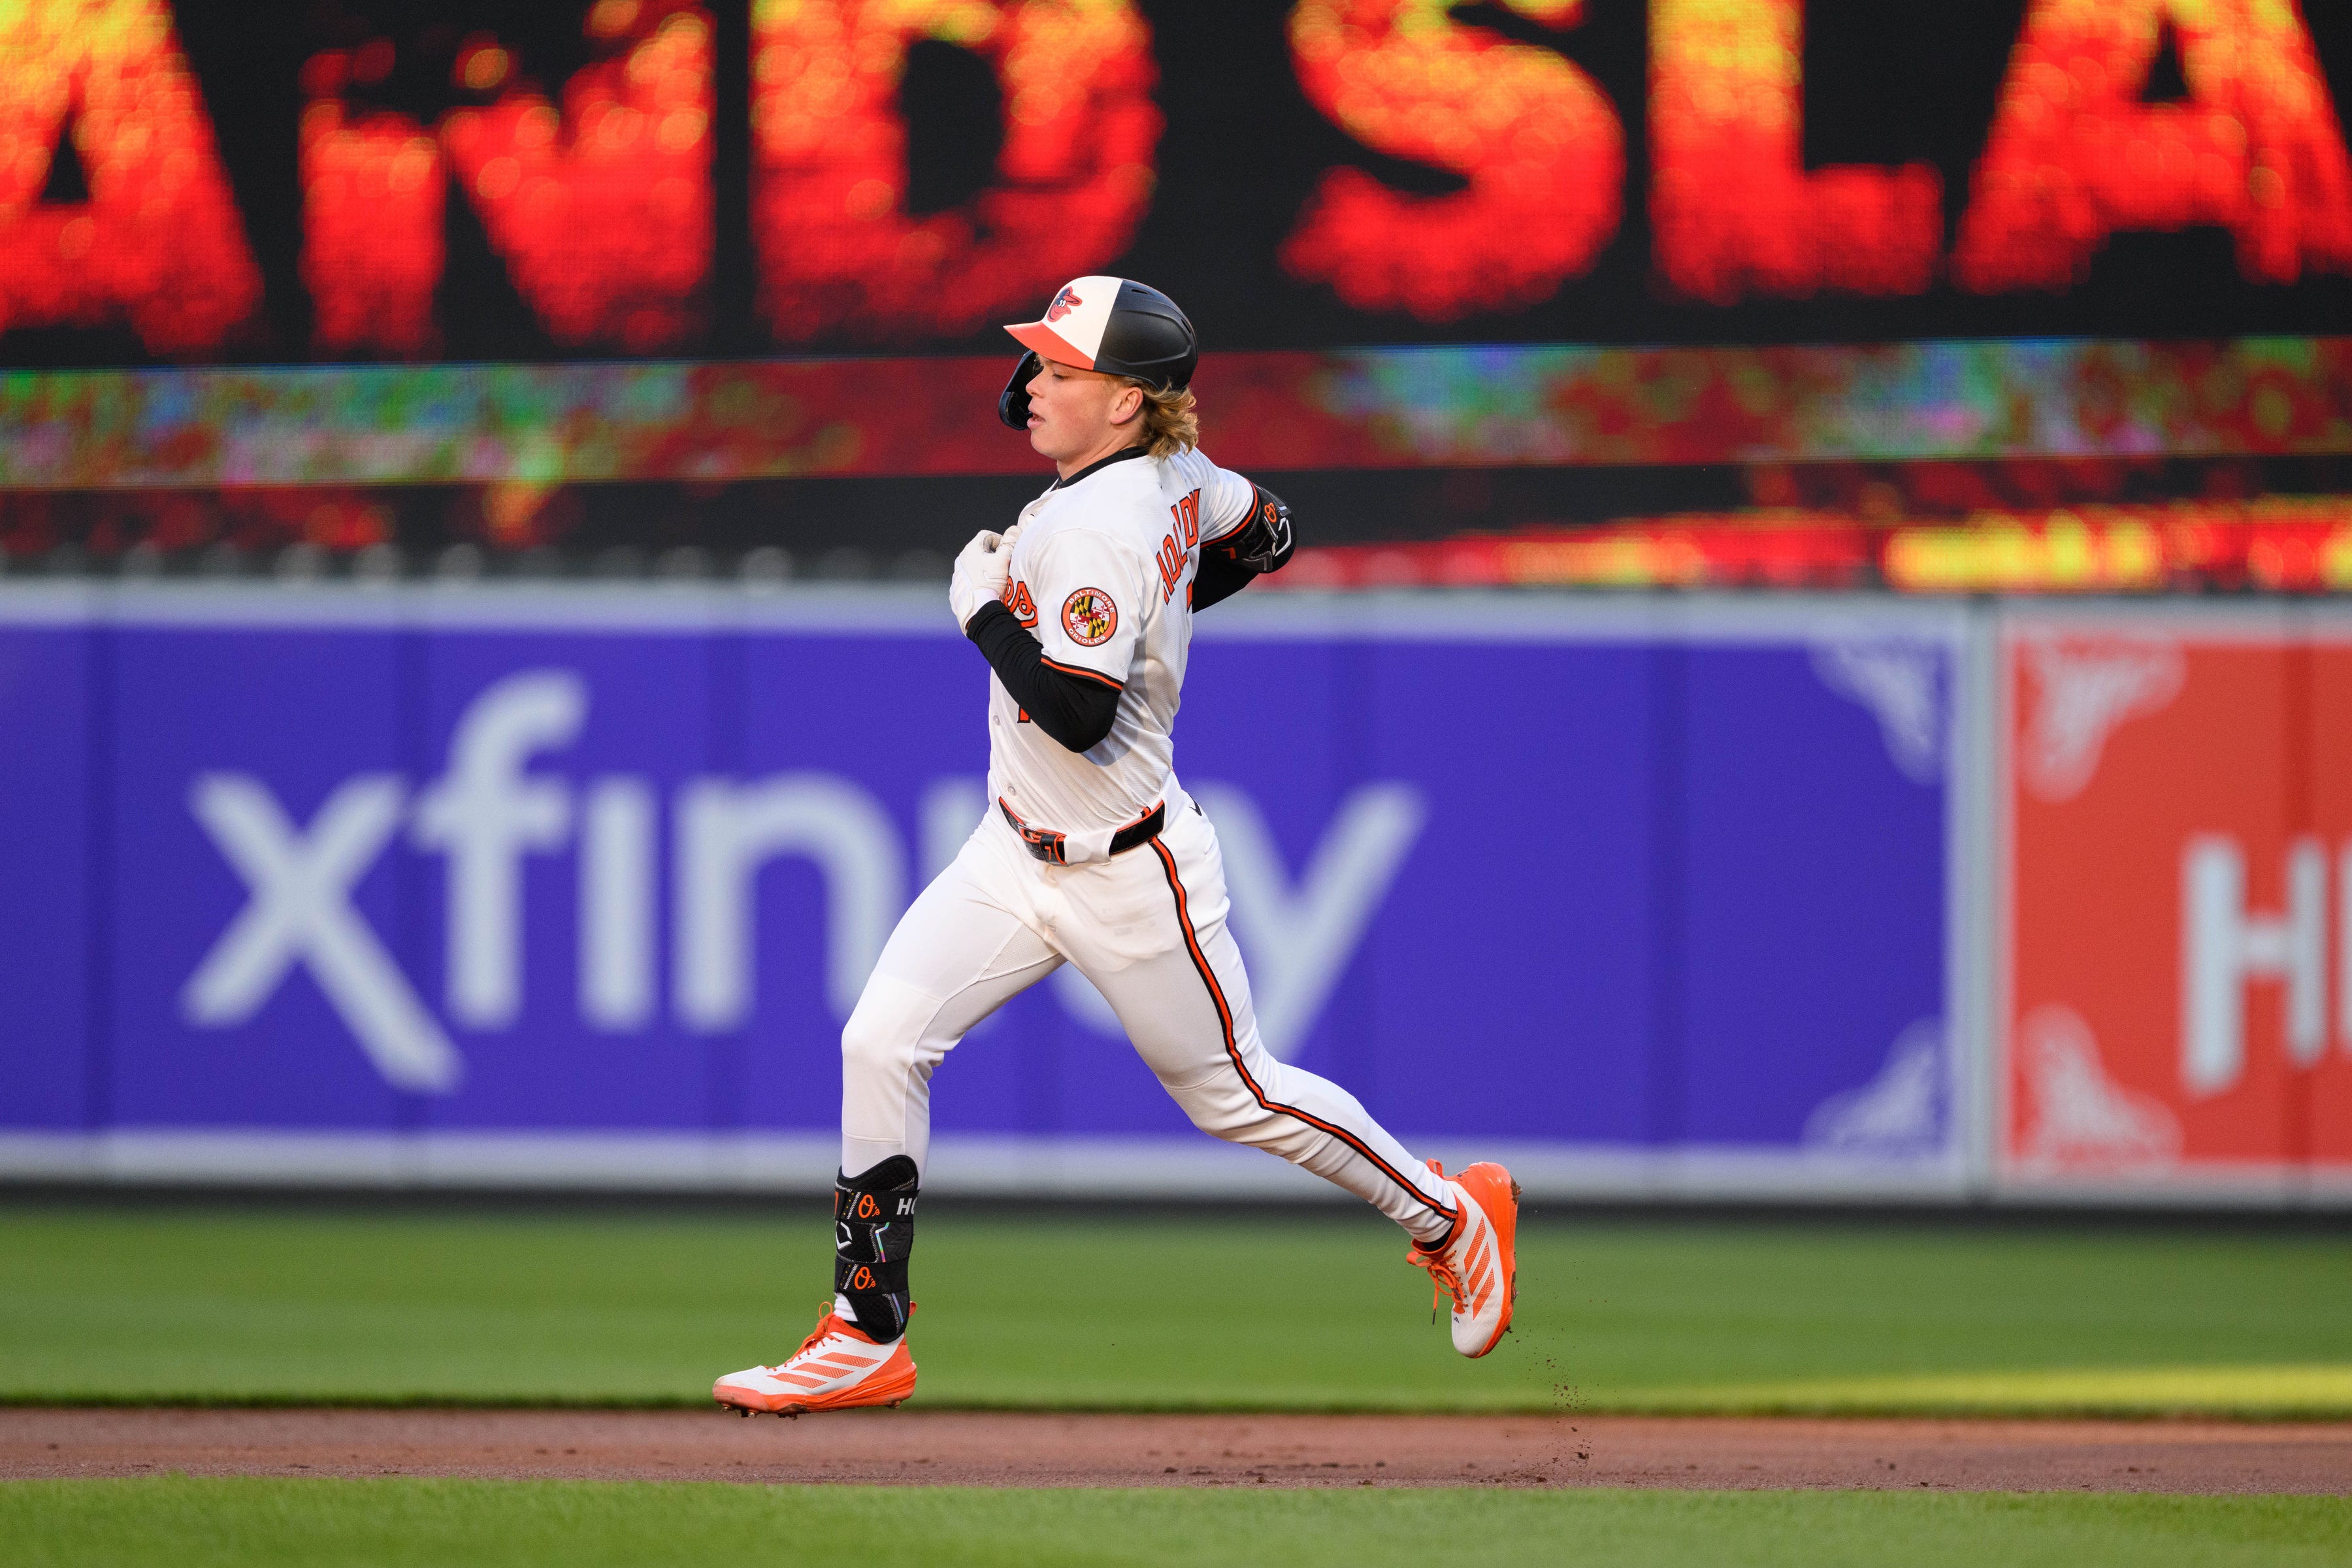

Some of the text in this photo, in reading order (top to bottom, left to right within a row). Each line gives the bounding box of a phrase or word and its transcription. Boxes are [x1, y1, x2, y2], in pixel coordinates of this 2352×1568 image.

[1281, 0, 2352, 321] SLA
[1068, 589, 1115, 613] BALTIMORE
[1068, 628, 1105, 644] ORIOLES
[182, 668, 1431, 1096] xfiny
[2181, 831, 2352, 1101] H
